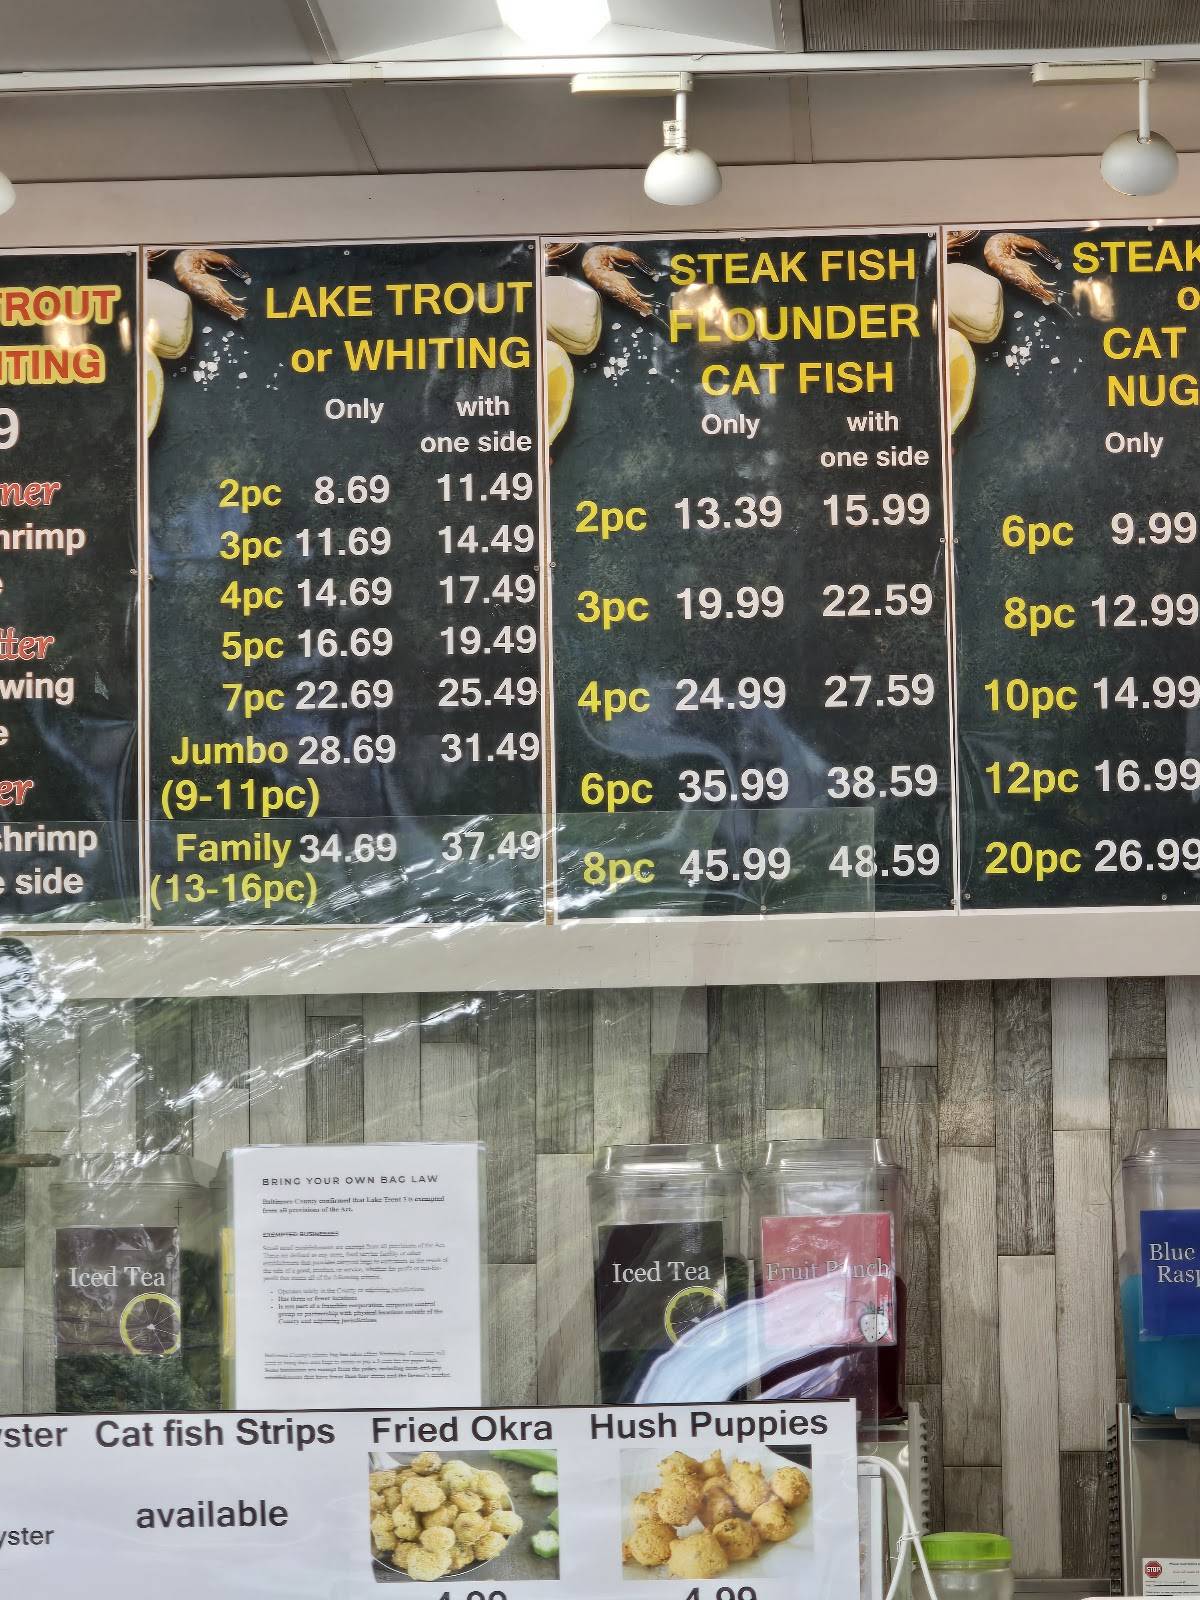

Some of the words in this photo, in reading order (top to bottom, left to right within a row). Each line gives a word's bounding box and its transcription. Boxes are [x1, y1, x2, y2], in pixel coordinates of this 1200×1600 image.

[669, 251, 806, 286] STEAK
[820, 248, 915, 281] FISH
[0, 285, 121, 326] ROUT
[265, 285, 373, 319] LAKE
[387, 281, 533, 316] TROUT
[669, 303, 920, 343] FLOUNDER
[291, 346, 332, 374] or
[344, 337, 531, 371] WHITING
[1103, 326, 1187, 360] CAT
[701, 364, 784, 398] CAT
[800, 362, 893, 394] FISH
[1107, 374, 1199, 408] NUG
[325, 398, 385, 424] Only
[456, 396, 510, 418] with
[701, 413, 760, 440] Only
[847, 411, 899, 433] with
[420, 434, 469, 453] one
[478, 431, 532, 452] side
[820, 448, 868, 469] one
[876, 446, 930, 467] side
[1105, 431, 1164, 458] Only
[219, 479, 282, 513] 2pc
[314, 476, 390, 505] 8.69
[436, 473, 533, 501] 11.49
[576, 500, 647, 539] 2pc
[674, 495, 782, 530] 13.39
[823, 493, 930, 527] 15.99
[1002, 515, 1074, 554] 6pc
[1111, 512, 1197, 546] 9.99
[219, 530, 283, 566] 3pc
[296, 528, 391, 557] 11.69
[438, 525, 534, 554] 14.49
[220, 581, 284, 614] 4pc
[298, 577, 392, 607] 14.69
[439, 575, 536, 604] 17.49
[577, 590, 649, 630] 3pc
[676, 586, 784, 620] 19.99
[822, 583, 933, 617] 22.59
[1004, 596, 1076, 636] 8pc
[1091, 593, 1199, 627] 12.99
[222, 632, 284, 666] 5pc
[298, 627, 393, 658] 16.69
[440, 626, 537, 655] 19.49
[0, 671, 74, 706] wing
[223, 683, 285, 718] 7pc
[296, 679, 393, 709] 22.69
[438, 677, 537, 707] 25.49
[578, 680, 650, 721] 4pc
[675, 676, 786, 711] 24.99
[824, 674, 935, 708] 27.59
[984, 679, 1077, 719] 10pc
[1093, 676, 1200, 709] 14.99
[171, 737, 288, 767] Jumbo
[299, 734, 397, 765] 28.69
[441, 733, 541, 763] 31.49
[161, 777, 320, 819] (9-11pc)
[581, 772, 653, 813] 6pc
[678, 767, 789, 803] 35.99
[827, 764, 938, 799] 38.59
[985, 761, 1079, 801] 12pc
[1095, 758, 1200, 792] 16.99
[0, 824, 98, 858] hrimp
[177, 832, 292, 869] Family
[299, 833, 397, 863] 34.69
[442, 830, 541, 860] 37.49
[985, 841, 1082, 881] 20pc
[1094, 838, 1200, 872] 26.99
[15, 866, 84, 895] side
[583, 851, 655, 890] 8pc
[679, 847, 791, 884] 45.99
[828, 844, 940, 878] 48.59
[150, 872, 318, 911] (13-16pc)
[262, 1178, 301, 1186] BRING
[306, 1177, 340, 1185] YOUR
[381, 1176, 406, 1184] BAG
[411, 1175, 438, 1183] LAW
[766, 1261, 820, 1280] Fruit
[826, 1257, 890, 1279] Pnch
[1149, 1242, 1196, 1261] Blue
[68, 1266, 118, 1287] Iced
[124, 1266, 166, 1287] Tea
[612, 1261, 662, 1283] Iced
[667, 1261, 711, 1281] Tea
[0, 1423, 68, 1448] ster
[95, 1420, 153, 1447] Cat
[164, 1419, 223, 1446] fish
[236, 1418, 335, 1451] Strips
[372, 1416, 458, 1443] Fried
[471, 1415, 553, 1441] Okra
[590, 1412, 676, 1440] Hush
[691, 1410, 828, 1443] Puppies
[136, 1500, 288, 1529] available
